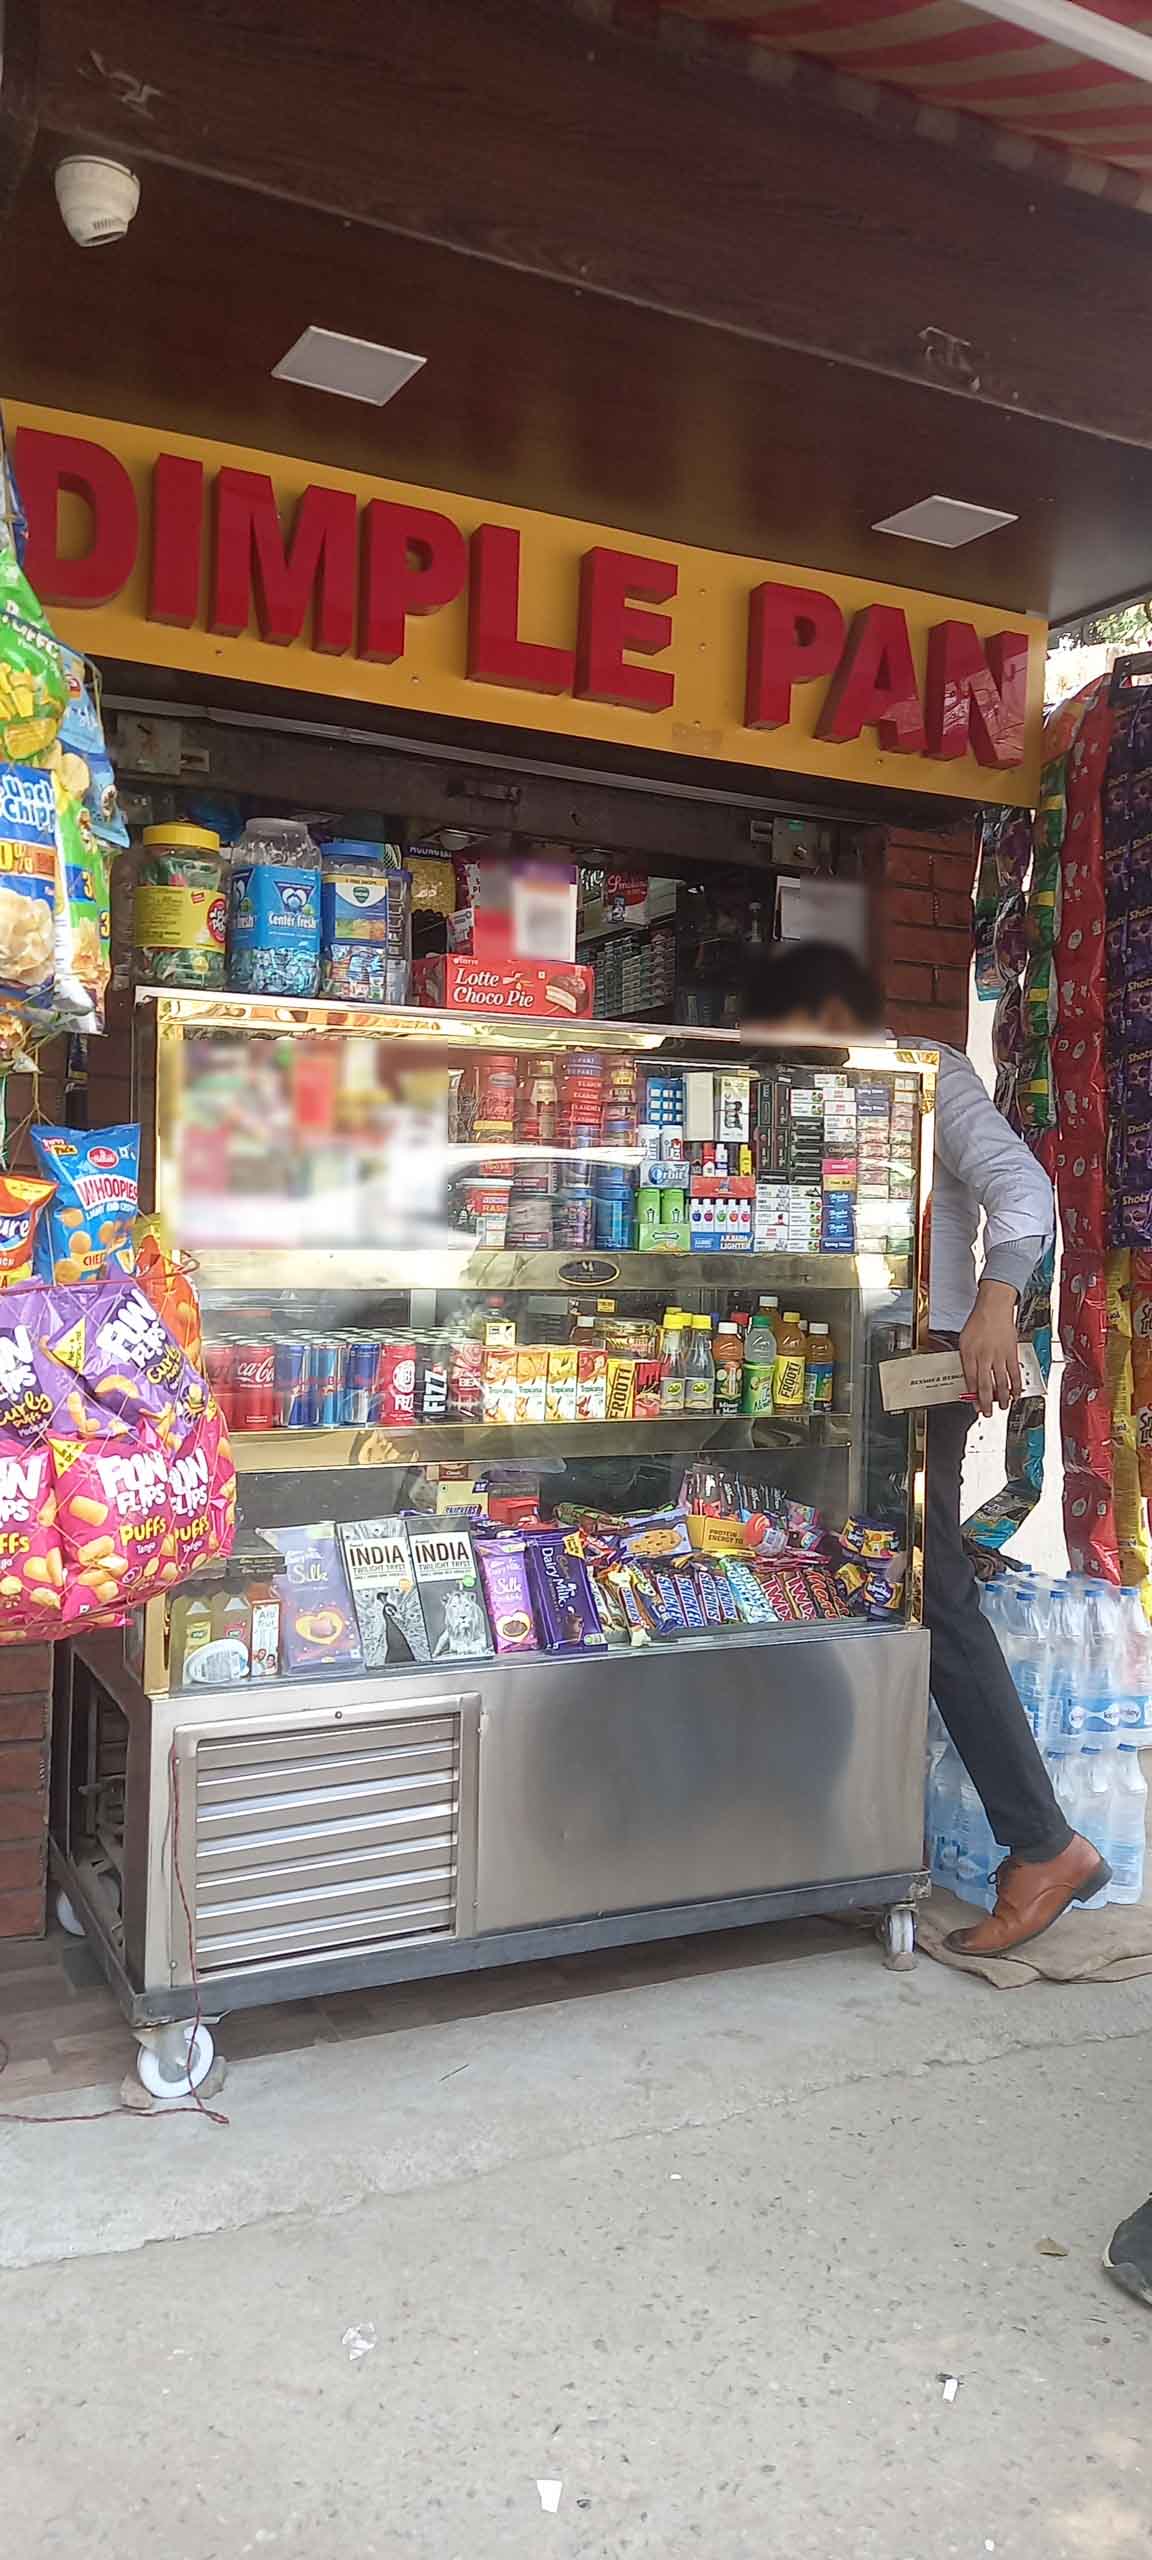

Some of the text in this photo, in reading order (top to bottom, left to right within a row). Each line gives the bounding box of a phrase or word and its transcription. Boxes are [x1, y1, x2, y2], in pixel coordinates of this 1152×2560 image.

[15, 425, 1029, 769] DIMPLE PAN
[454, 967, 500, 987] Lotte
[453, 986, 533, 1008] Choco Pie
[648, 1163, 684, 1185] Orbit
[77, 1177, 138, 1207] WHOOPIES
[423, 1368, 448, 1412] FIZZ
[608, 1367, 632, 1419] FROOTI
[780, 1361, 800, 1399] FROOTI
[96, 1449, 168, 1500] FUN
[116, 1483, 167, 1516] FLIPS
[349, 1544, 405, 1567] INDIA
[415, 1541, 470, 1564] INDIA
[288, 1564, 329, 1584] Silk
[541, 1547, 569, 1608] Dairy Milk
